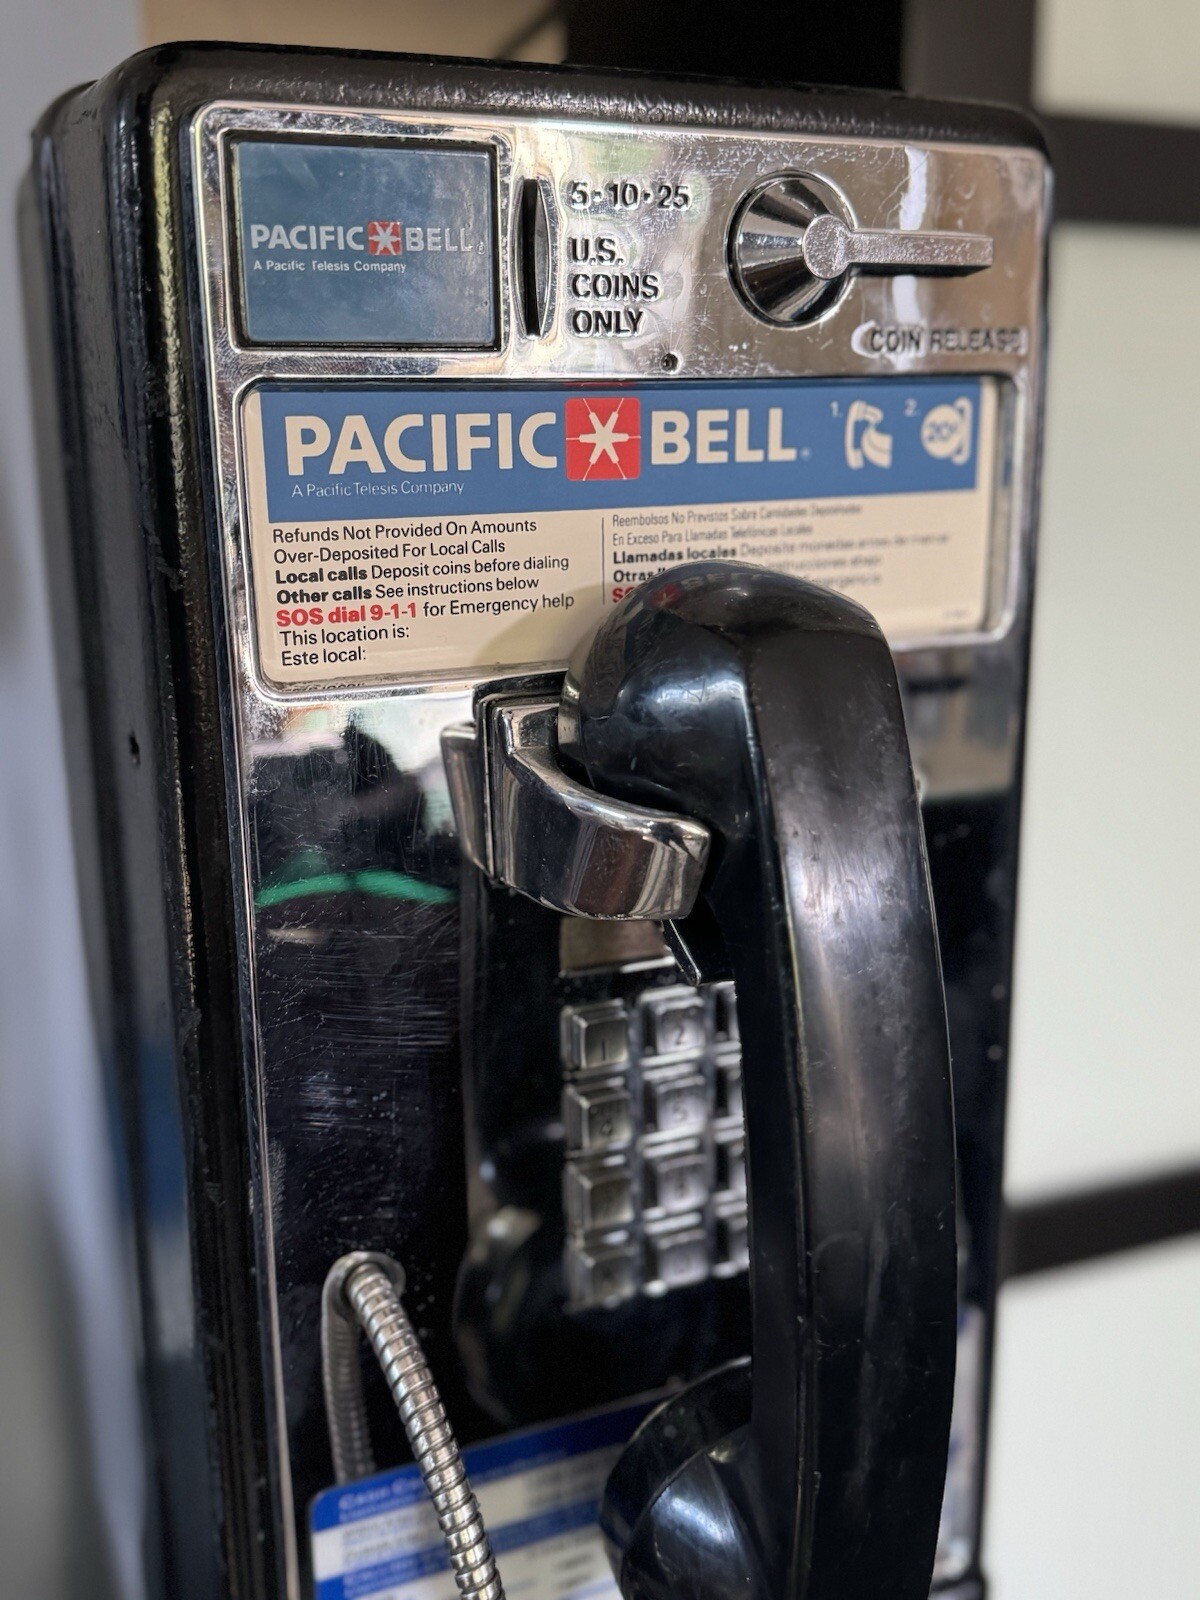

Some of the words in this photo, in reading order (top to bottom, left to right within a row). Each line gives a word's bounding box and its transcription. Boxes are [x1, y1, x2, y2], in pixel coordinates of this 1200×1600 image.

[250, 224, 364, 250] PACIFIC
[405, 227, 473, 252] BELL
[571, 237, 625, 263] U.S.
[253, 260, 262, 271] A
[266, 260, 305, 271] Pacific
[311, 260, 350, 272] Telesis
[354, 260, 407, 274] Company
[571, 273, 660, 299] COINS
[571, 310, 644, 335] ONLY
[869, 328, 921, 352] COIN
[929, 327, 1022, 353] RELEASE
[284, 411, 558, 476] PACIFIC
[651, 407, 797, 465] BELL
[291, 484, 304, 498] A
[306, 482, 351, 498] Pacific
[353, 481, 398, 496] Telesis
[401, 480, 465, 496] Company
[273, 527, 340, 543] Refunds
[343, 525, 372, 541] Not
[375, 523, 443, 539] Provided
[446, 521, 467, 536] On
[471, 519, 537, 535] Amounts
[612, 514, 669, 527] Reembolsos
[671, 512, 684, 525] No
[612, 533, 625, 546] En
[627, 532, 660, 546] Exceso
[662, 530, 683, 543] Para
[273, 542, 399, 565] Over-Deposited
[403, 542, 427, 558] For
[430, 540, 468, 556] Local
[472, 539, 505, 554] Calls
[613, 549, 683, 564] Llamadas
[687, 547, 737, 560] locales
[275, 568, 324, 584] Local
[327, 566, 368, 582] calls
[371, 563, 429, 581] Deposit
[433, 561, 471, 576] coins
[474, 557, 520, 573] before
[523, 555, 569, 573] dialing
[276, 588, 329, 604] Other
[332, 586, 372, 601] calls
[375, 584, 404, 599] See
[407, 578, 493, 598] instructions
[496, 575, 539, 592] below
[276, 607, 324, 627] SOS
[327, 604, 366, 624] dial
[369, 602, 417, 621] 9-1-1
[423, 602, 445, 617] for
[450, 595, 539, 616] Emergency
[542, 593, 575, 611] help
[280, 630, 318, 646] This
[321, 626, 388, 645] location
[392, 625, 410, 639] is:
[281, 650, 319, 667] Este
[323, 646, 367, 663] local:
[672, 1021, 686, 1046] 2
